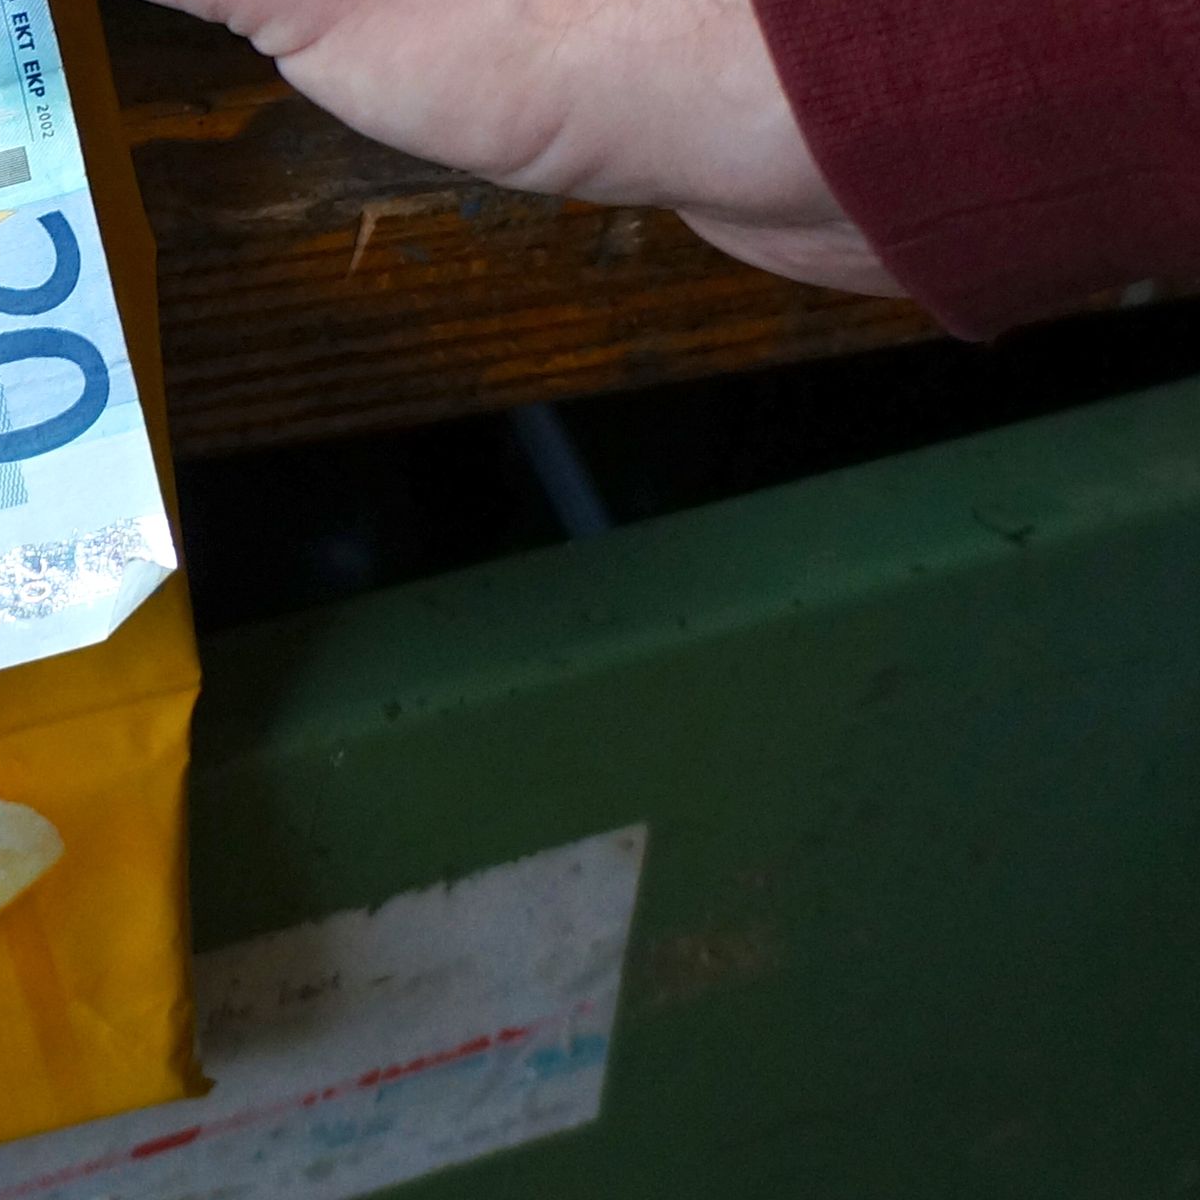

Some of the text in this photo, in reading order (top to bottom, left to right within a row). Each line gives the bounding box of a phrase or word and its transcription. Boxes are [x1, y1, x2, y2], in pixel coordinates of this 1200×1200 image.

[11, 11, 35, 51] EKT
[22, 59, 45, 98] EKP
[36, 104, 54, 140] 2002
